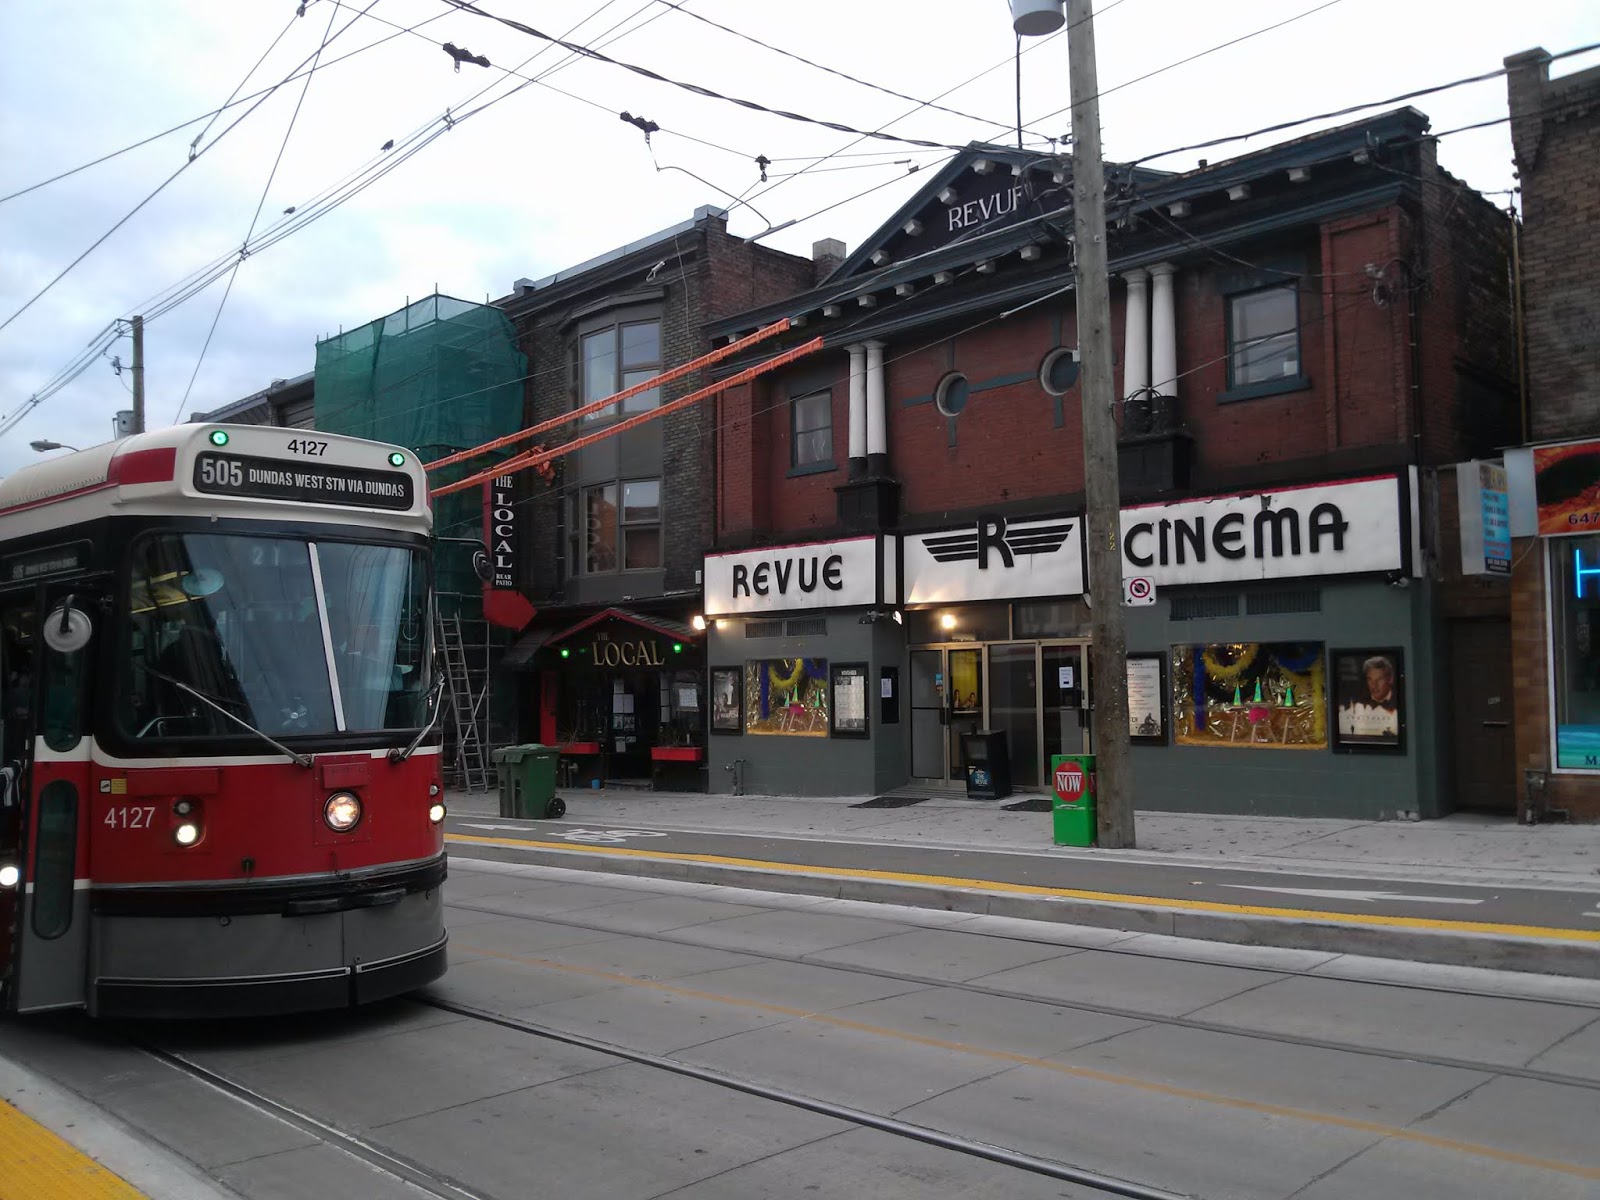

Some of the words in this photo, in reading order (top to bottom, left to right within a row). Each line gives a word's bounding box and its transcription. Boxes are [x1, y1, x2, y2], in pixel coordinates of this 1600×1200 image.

[287, 439, 328, 457] 4127
[202, 458, 243, 487] 505
[249, 469, 293, 486] DUNDAS
[295, 473, 324, 489] WEST
[326, 476, 346, 491] STN
[347, 477, 364, 493] VIA
[365, 480, 405, 498] DUNDAS
[495, 475, 514, 489] THE
[494, 492, 514, 569] LOCAL
[1567, 512, 1600, 526] 647
[1123, 502, 1350, 567] CINEMA
[732, 554, 843, 599] REVUE
[591, 640, 666, 667] LOCAL
[1585, 754, 1600, 766] M
[1056, 774, 1082, 792] NOW
[104, 806, 156, 829] 4127
